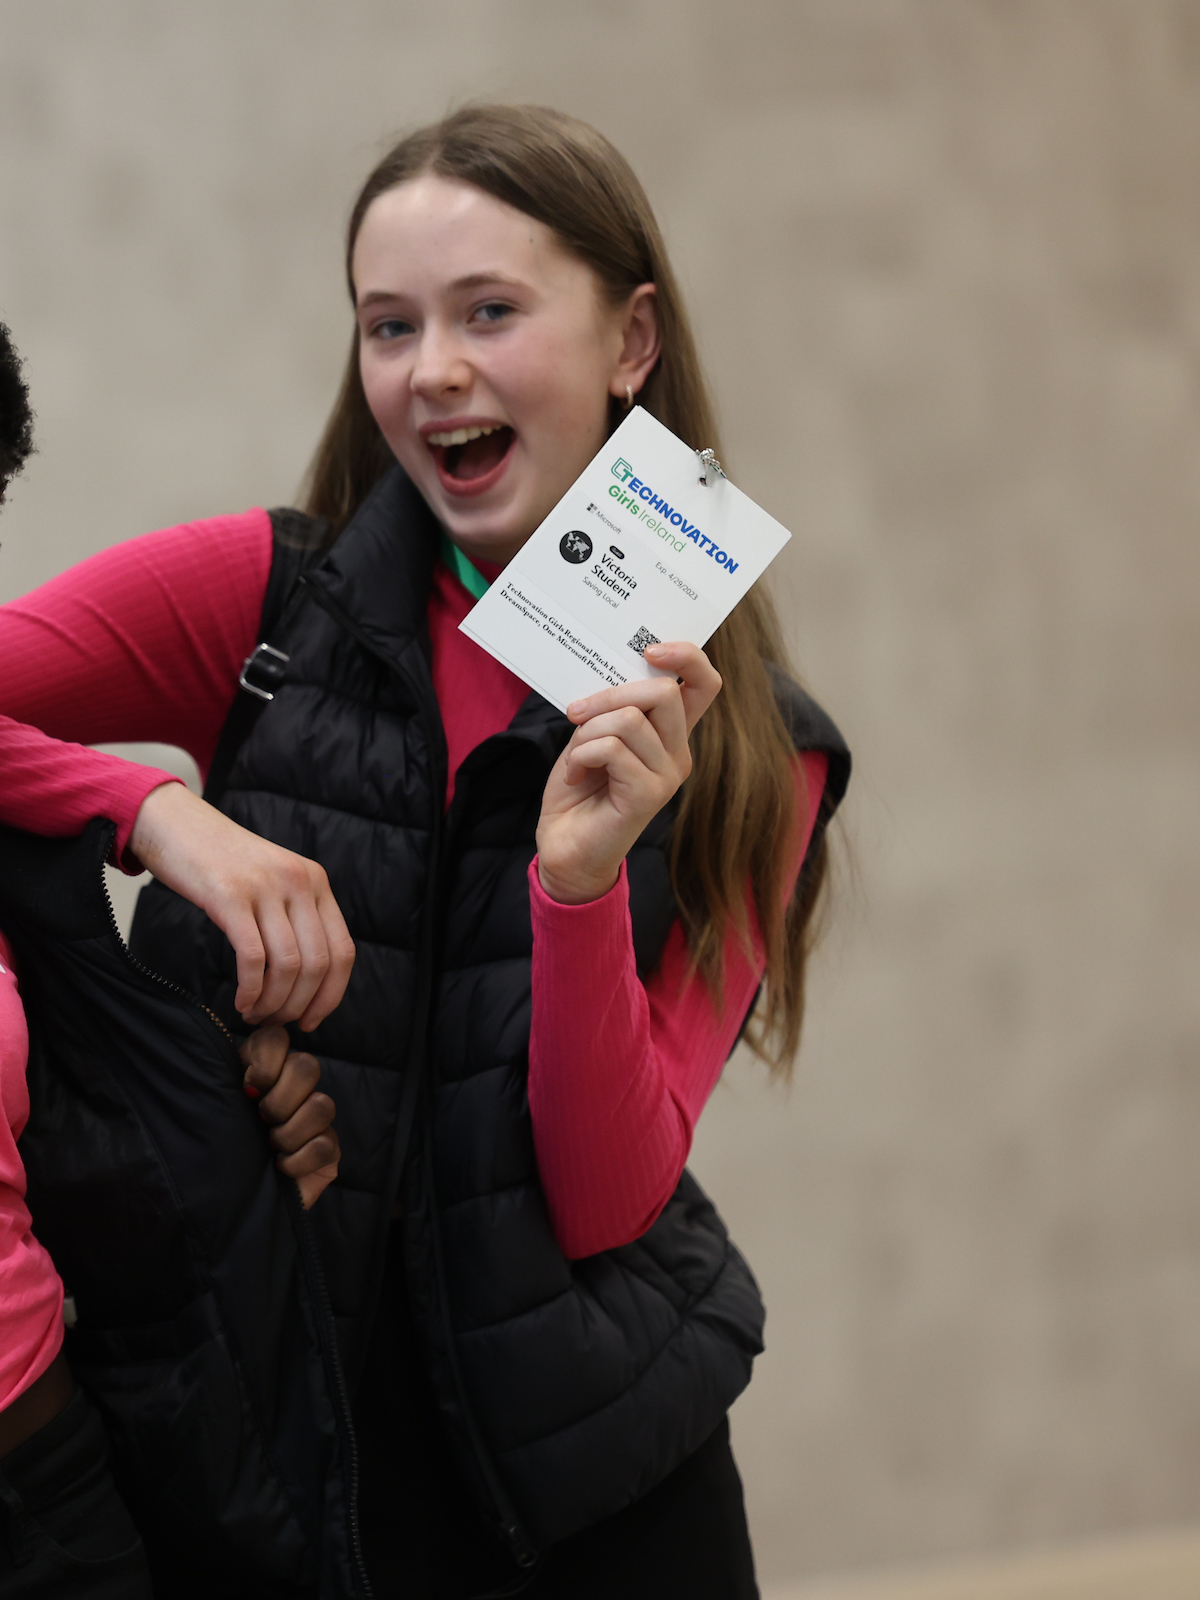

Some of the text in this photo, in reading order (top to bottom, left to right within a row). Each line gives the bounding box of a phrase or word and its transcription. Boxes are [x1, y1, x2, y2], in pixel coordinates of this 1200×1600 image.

[596, 511, 621, 534] Microsoft
[609, 485, 687, 552] Girls Ireland
[620, 469, 739, 574] TECHNOVATION
[591, 565, 630, 600] Student
[602, 554, 637, 589] Victoria
[655, 562, 698, 600] Exp. 4/29/2023
[582, 577, 619, 608] Saving Local
[500, 590, 540, 626] DreamSpace,
[543, 625, 555, 636] One
[557, 636, 587, 662] Microsoft
[587, 660, 604, 678] Place,
[507, 582, 627, 683] Technovation Girls Regional Pitch Event
